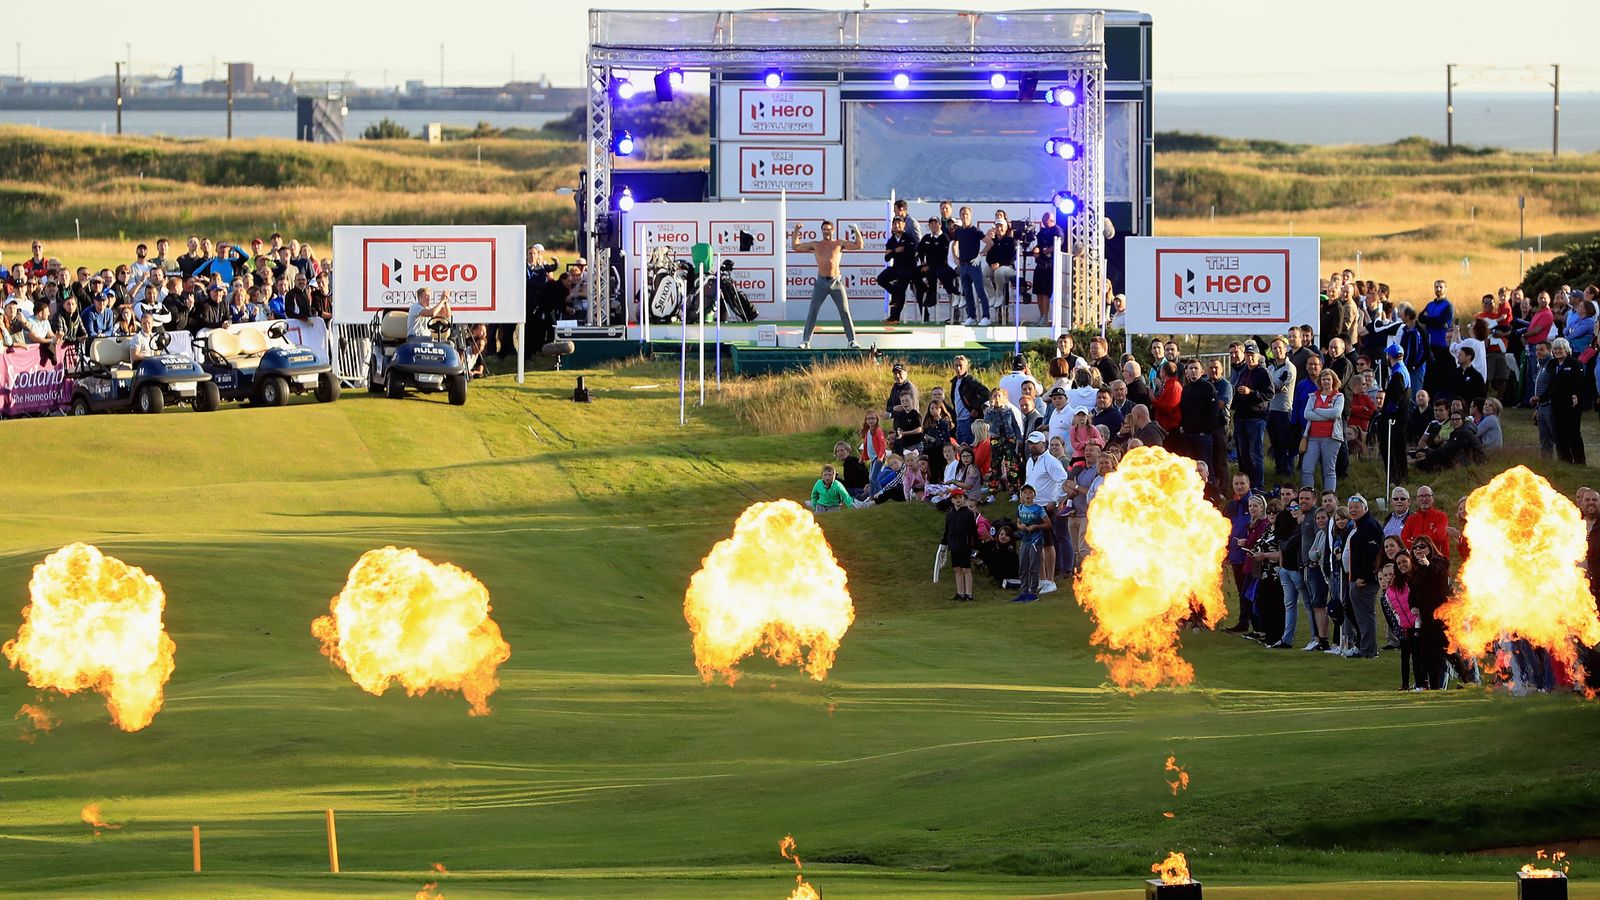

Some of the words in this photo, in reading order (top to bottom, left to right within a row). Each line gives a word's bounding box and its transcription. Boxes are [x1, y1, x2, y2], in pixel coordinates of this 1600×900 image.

[771, 93, 793, 102] THE
[772, 105, 813, 117] Hero
[752, 122, 814, 131] CHALLENGE
[771, 152, 794, 161] THE
[772, 164, 813, 175] Hero
[752, 180, 814, 190] CHALLENGE
[658, 233, 689, 242] Hero
[734, 233, 765, 242] Ho
[413, 245, 446, 259] THE
[1205, 256, 1239, 270] THE
[414, 264, 477, 282] Hero
[734, 280, 766, 289] Hero
[860, 277, 878, 286] He
[1206, 275, 1271, 293] Hero
[655, 279, 673, 312] SRIXON
[1174, 302, 1271, 315] CHALLENGE
[413, 347, 445, 355] RULES
[5, 365, 65, 391] Scotland
[24, 392, 44, 402] Home
